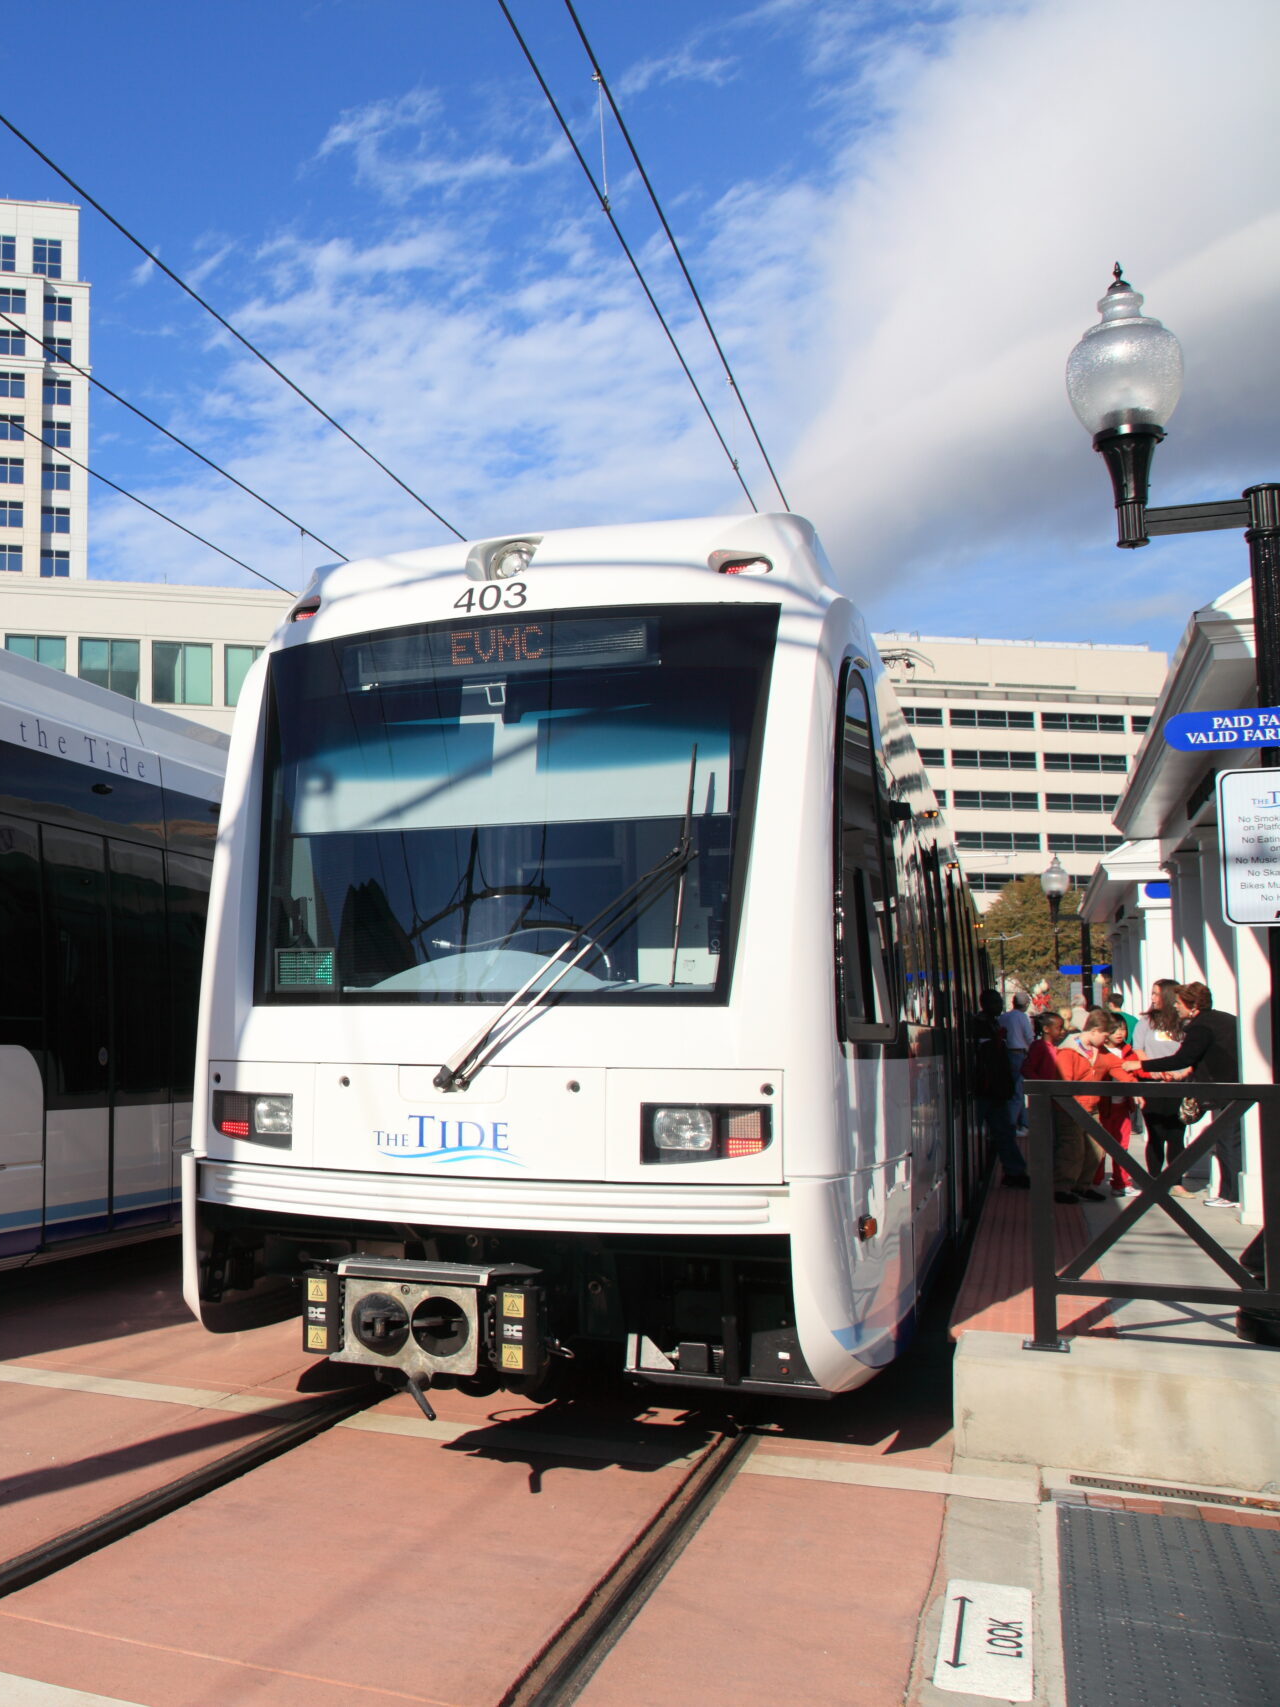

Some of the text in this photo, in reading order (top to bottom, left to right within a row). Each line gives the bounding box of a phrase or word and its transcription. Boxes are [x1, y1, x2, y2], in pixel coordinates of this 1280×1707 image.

[453, 582, 527, 613] 403
[450, 625, 544, 665] EVMC
[1212, 715, 1254, 729] PAID
[1185, 730, 1239, 744] VALID
[20, 719, 67, 754] the
[84, 735, 145, 778] Tide
[1242, 836, 1255, 844] No
[1235, 856, 1277, 865] No Music
[1247, 869, 1261, 877] No
[1240, 882, 1265, 890] Bikes
[1260, 893, 1274, 901] No
[373, 1114, 509, 1151] THE TIDE
[986, 1618, 1023, 1659] LOOK
